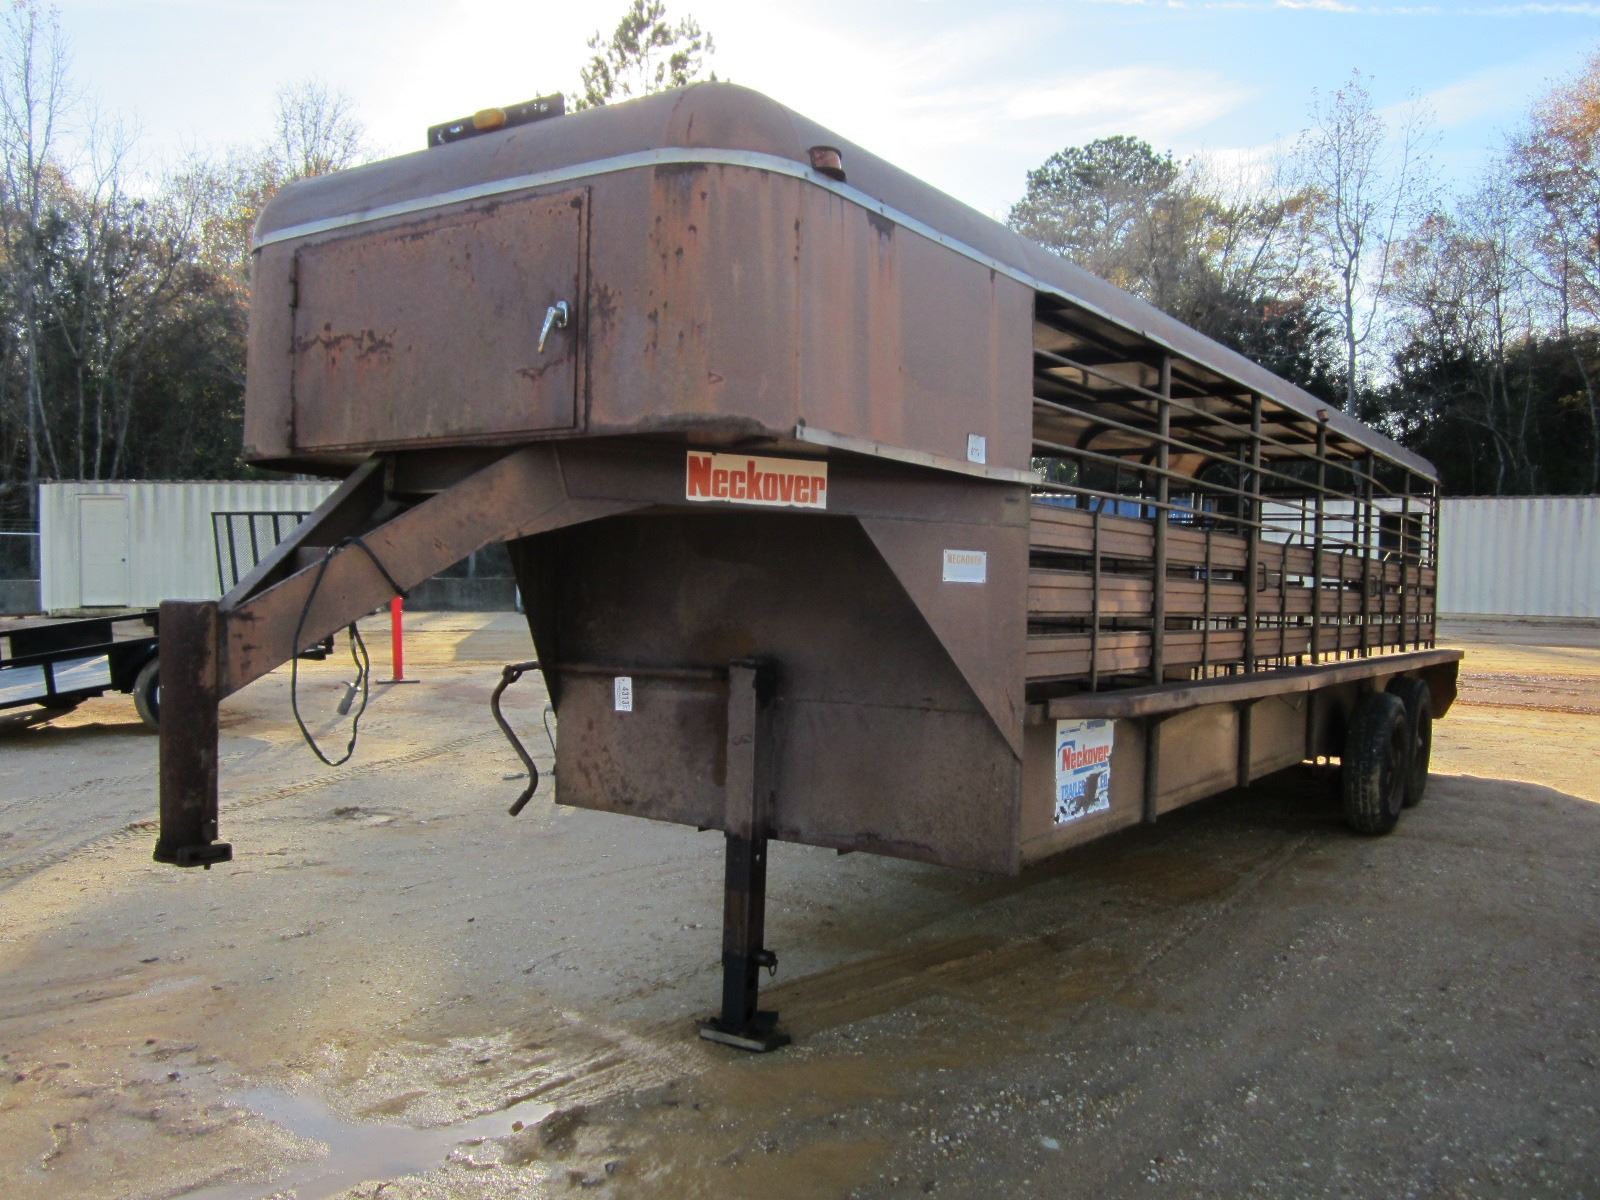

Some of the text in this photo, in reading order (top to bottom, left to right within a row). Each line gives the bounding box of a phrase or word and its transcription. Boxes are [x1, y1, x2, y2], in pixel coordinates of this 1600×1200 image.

[688, 455, 826, 504] Neckover
[621, 686, 630, 705] 4313
[1062, 743, 1109, 772] Neckover
